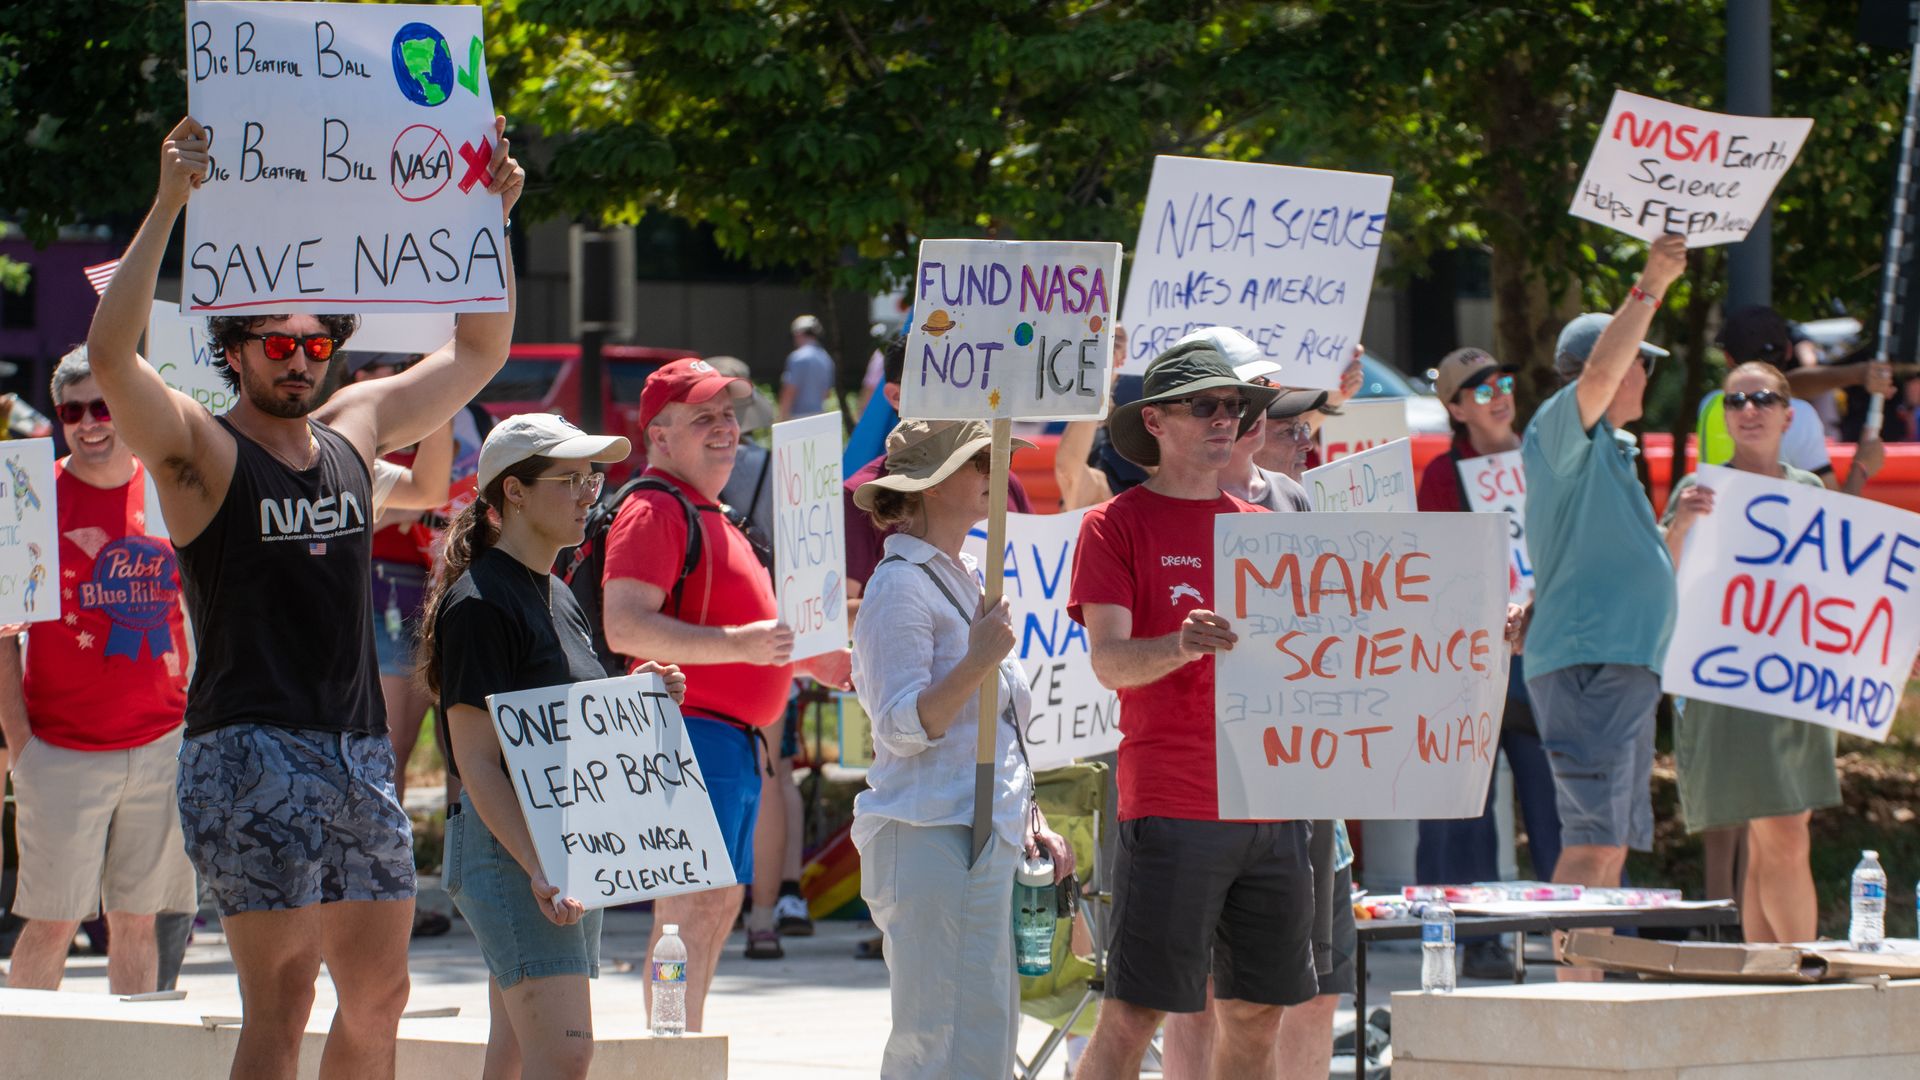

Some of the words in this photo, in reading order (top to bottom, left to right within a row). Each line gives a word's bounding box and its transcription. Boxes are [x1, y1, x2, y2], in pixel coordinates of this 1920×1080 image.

[315, 21, 371, 78] BALL
[391, 150, 451, 185] NASA
[1612, 111, 1720, 163] NASA
[1723, 135, 1787, 170] Earth
[1628, 158, 1741, 199] Science
[1156, 191, 1256, 258] NASA
[1264, 198, 1387, 250] SCIENCE
[1583, 179, 1633, 221] Helps
[1637, 199, 1718, 235] FEED
[191, 237, 325, 306] SAVE
[354, 227, 505, 294] NASA
[920, 262, 1012, 306] FUND
[1019, 264, 1110, 314] NASA
[1149, 270, 1232, 316] MAKES
[1240, 275, 1347, 311] AMERICA
[921, 342, 1004, 390] NOT
[1035, 336, 1099, 400] ICE
[1295, 328, 1348, 365] RICH
[261, 491, 364, 534] NASA
[778, 502, 837, 572] NASA
[106, 548, 166, 579] Pabst
[1161, 556, 1201, 568] DREAMS
[1735, 494, 1920, 592] SAVE
[81, 583, 127, 607] Blue
[1235, 552, 1431, 619] MAKE
[1721, 574, 1893, 665] NASA
[1275, 628, 1490, 680] SCIENCE
[1692, 645, 1895, 728] GODDARD
[497, 700, 571, 747] ONE
[581, 691, 669, 736] GIANT
[1263, 726, 1393, 768] NOT
[1418, 712, 1491, 765] WAR
[521, 760, 608, 809] LEAP
[616, 750, 707, 795] BACK
[561, 832, 626, 856] FUND
[639, 826, 693, 850] NASA
[594, 850, 711, 896] SCIENCE!
